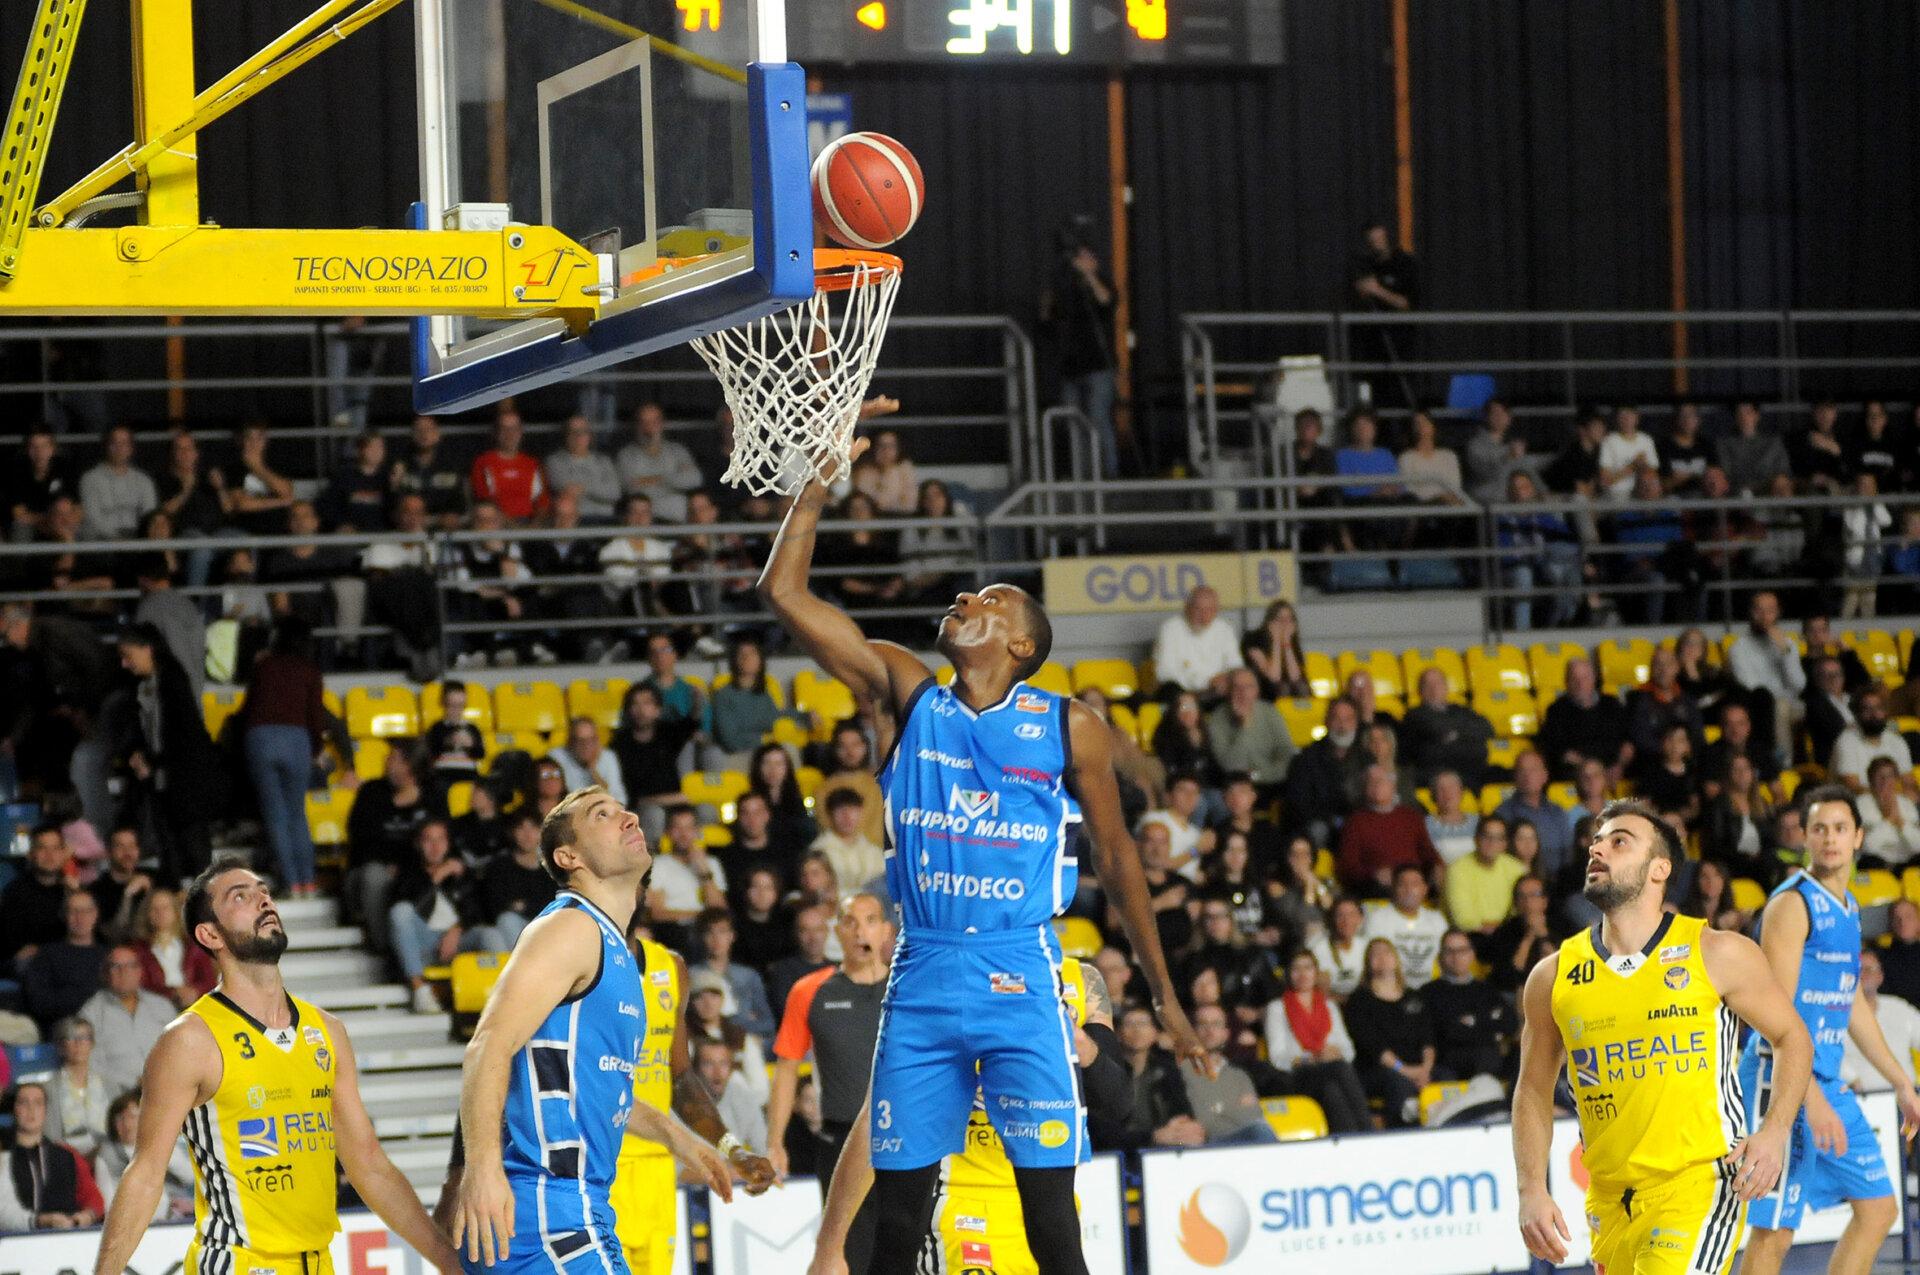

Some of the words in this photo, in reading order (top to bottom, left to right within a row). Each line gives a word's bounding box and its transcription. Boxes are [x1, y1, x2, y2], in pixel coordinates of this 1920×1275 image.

[293, 256, 488, 281] TECNOSPAZIO
[294, 286, 329, 294] IMPIANTI
[331, 286, 366, 294] SPORTIVI
[374, 286, 402, 294] SERIATE
[1085, 562, 1205, 605] GOLD
[1257, 559, 1281, 597] B
[973, 818, 1048, 843] MASCIO
[932, 871, 1025, 900] FLYDECO
[1566, 959, 1595, 986] 40
[1648, 1004, 1698, 1020] LAVAZZA
[233, 1031, 256, 1060] 3
[1605, 1031, 1707, 1065] REALE
[1608, 1056, 1708, 1083] MUTUA
[283, 1112, 334, 1135] REAL
[877, 1099, 892, 1130] 3
[872, 1137, 903, 1153] EA7
[1260, 1171, 1500, 1232] simecom
[1281, 1236, 1327, 1254] LUCE
[1352, 1230, 1387, 1247] GAS
[1411, 1221, 1482, 1241] SERVIZI
